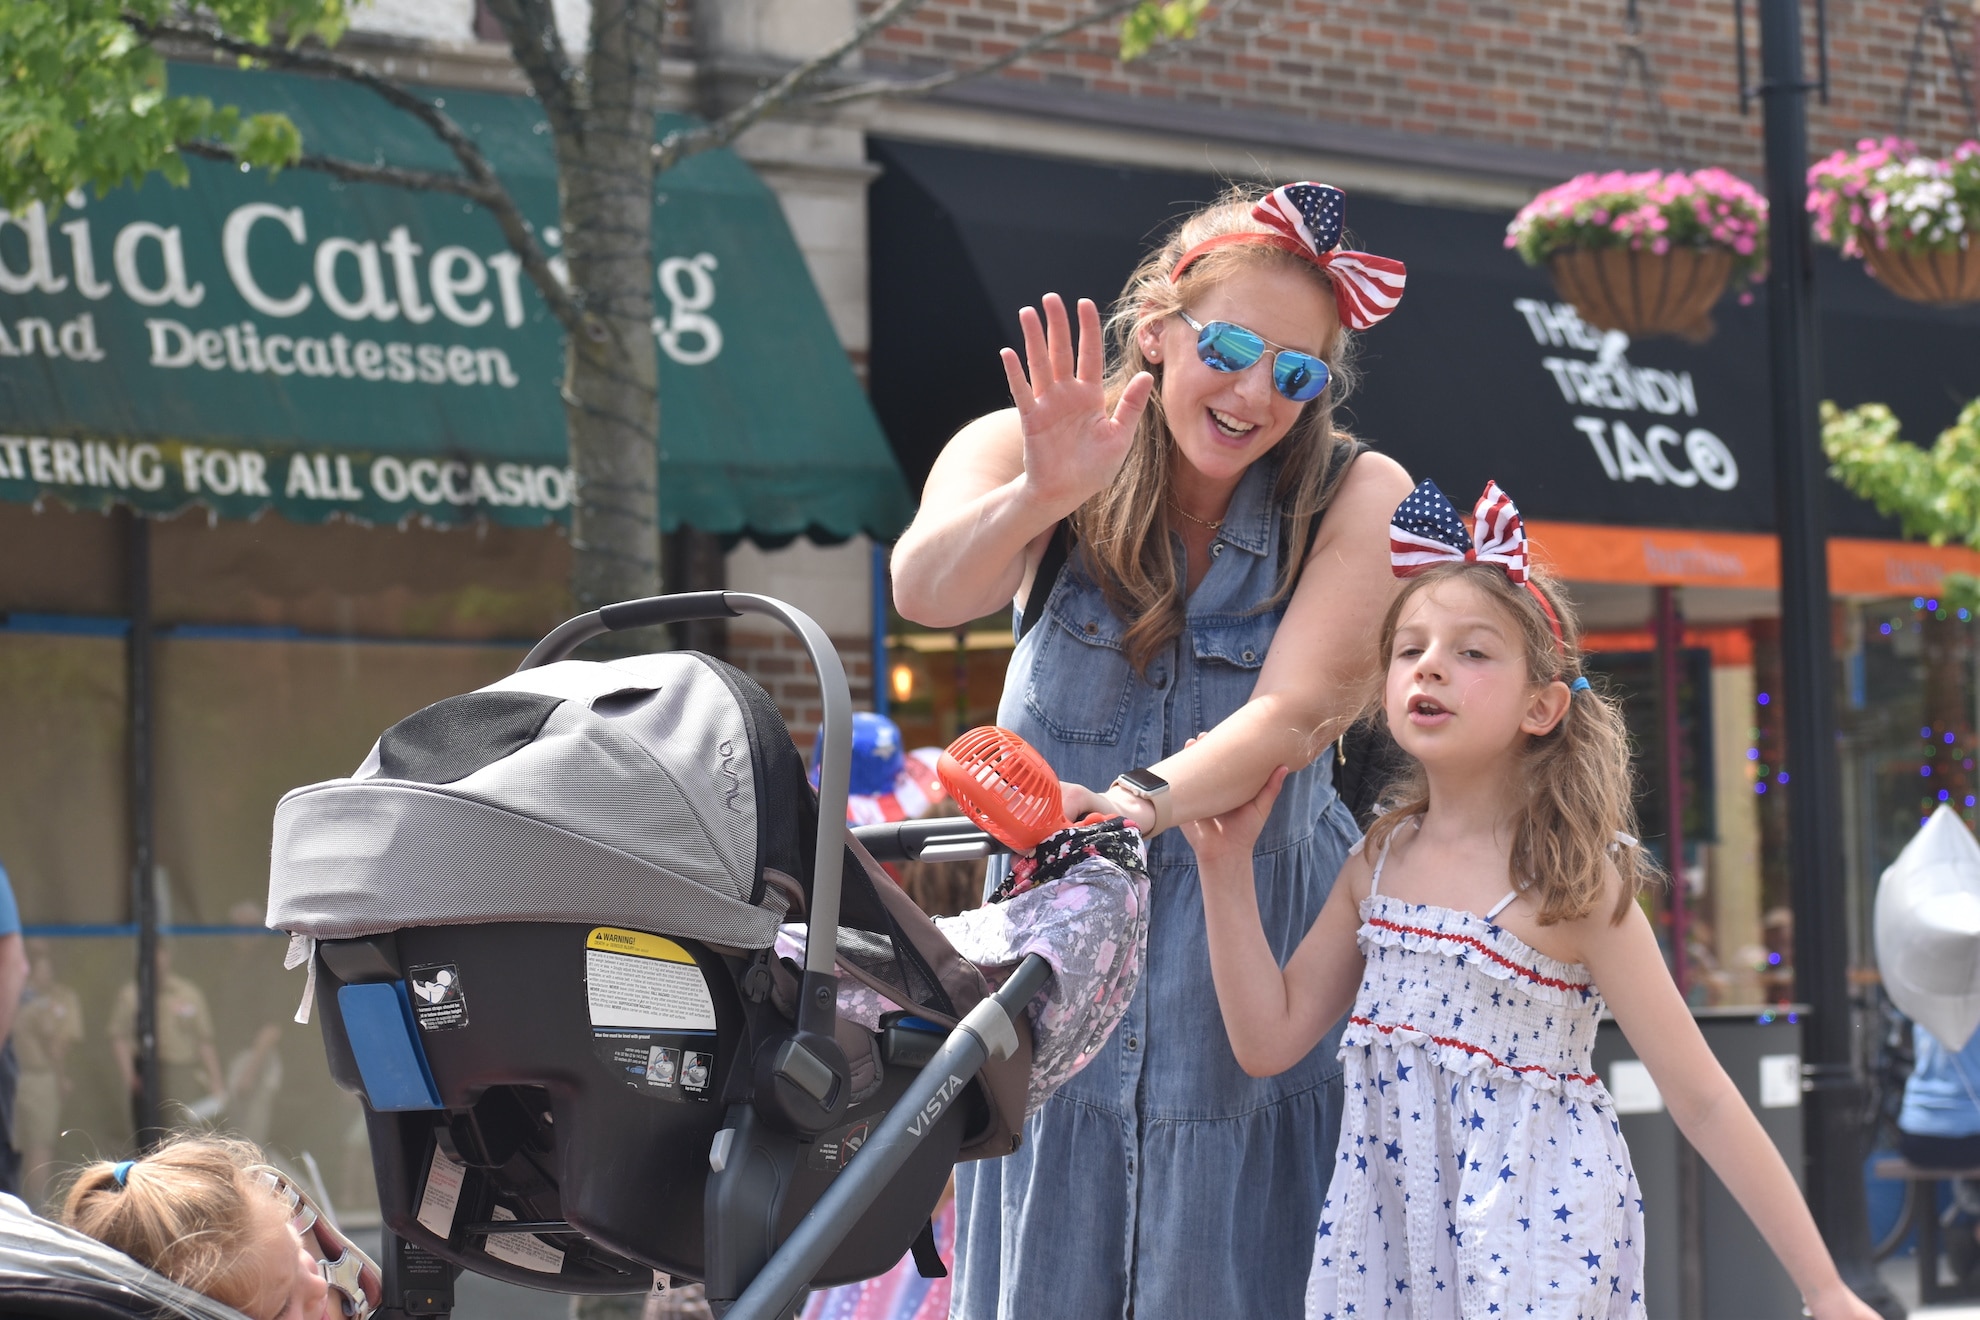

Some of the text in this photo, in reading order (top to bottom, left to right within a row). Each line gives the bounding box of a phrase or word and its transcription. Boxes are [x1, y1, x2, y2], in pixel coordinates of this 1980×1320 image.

[222, 203, 724, 366] Caterg
[144, 317, 519, 388] Delicatessen
[1541, 355, 1698, 418] TRENDY
[181, 446, 272, 498] FOR
[285, 452, 364, 501] ALL
[1573, 415, 1739, 491] TACO
[603, 932, 636, 945] WARNING!
[907, 1074, 963, 1137] VISTA
